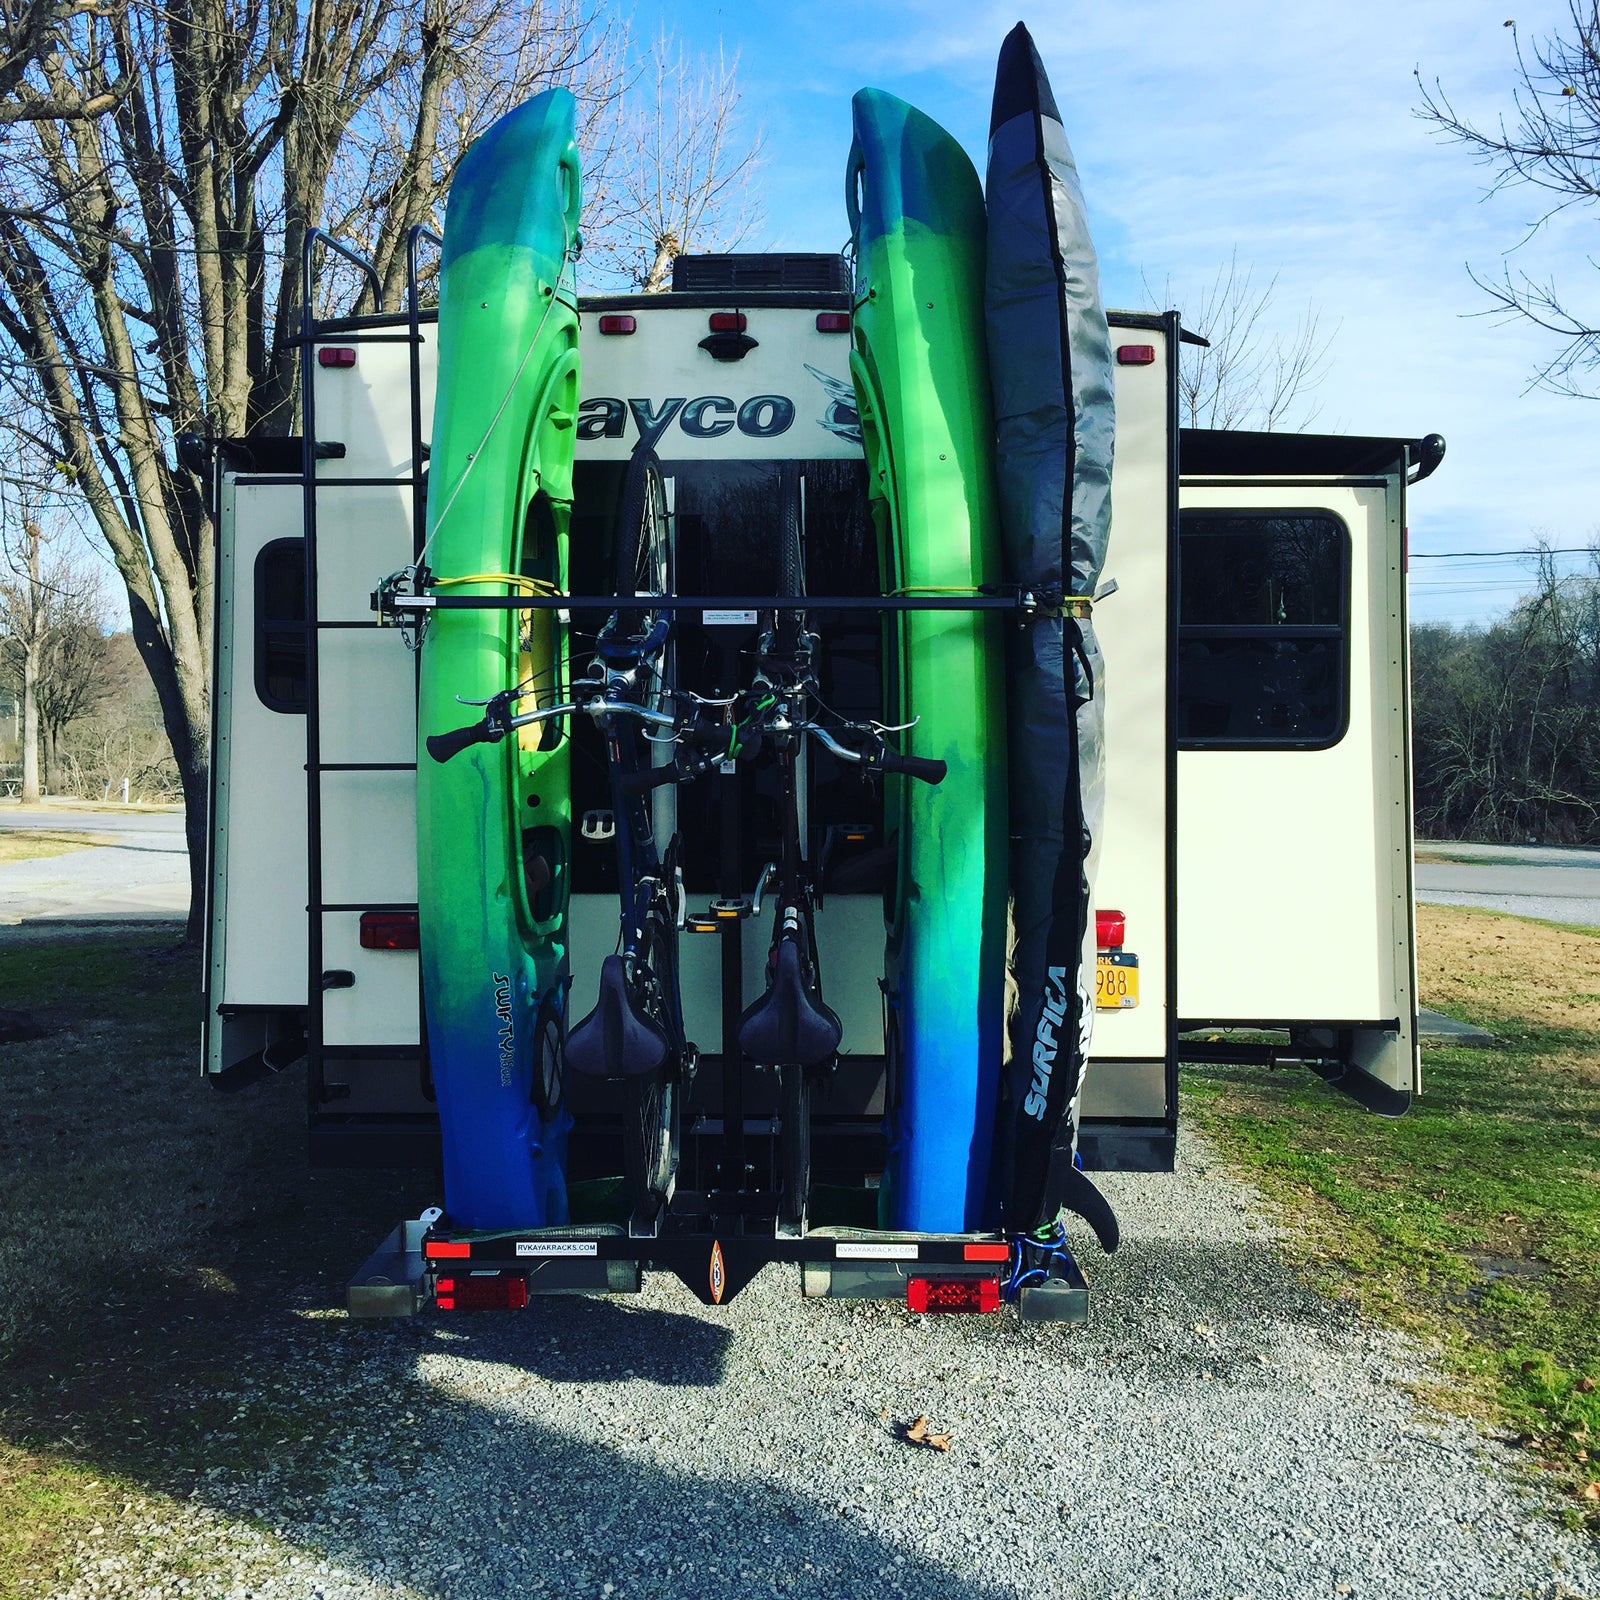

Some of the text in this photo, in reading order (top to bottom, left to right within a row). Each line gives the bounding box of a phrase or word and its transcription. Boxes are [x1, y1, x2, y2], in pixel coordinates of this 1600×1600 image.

[576, 395, 796, 452] ayco
[1097, 956, 1113, 966] RK
[1096, 970, 1127, 996] 988
[493, 972, 515, 1052] SWIFTY
